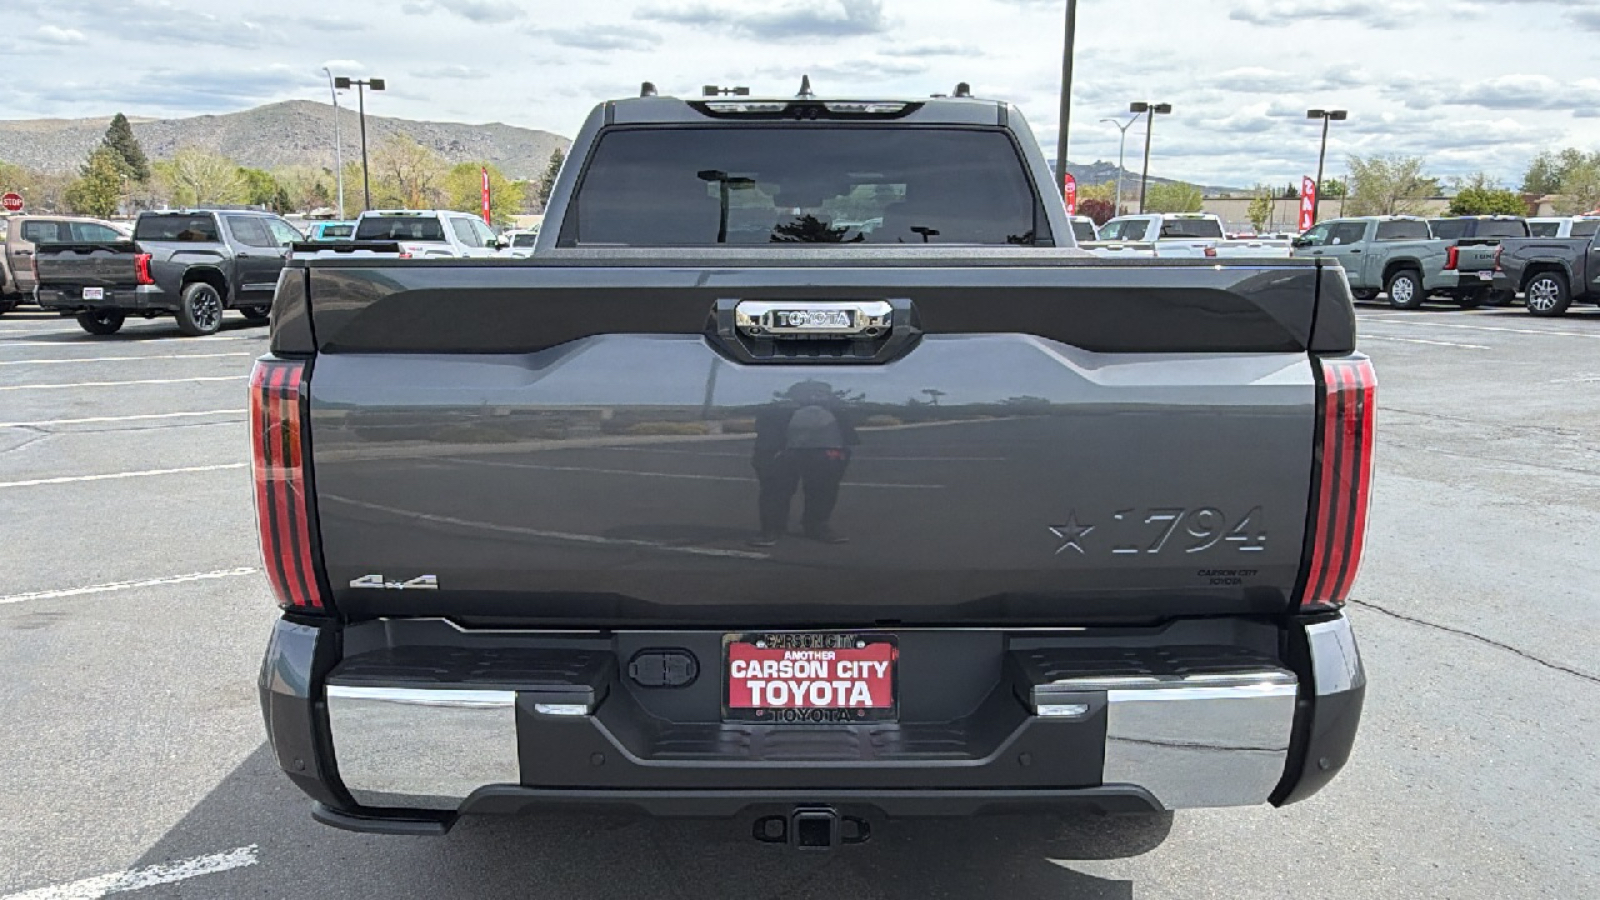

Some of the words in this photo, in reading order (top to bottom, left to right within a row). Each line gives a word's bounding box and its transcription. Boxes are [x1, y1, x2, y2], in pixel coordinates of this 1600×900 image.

[3, 198, 21, 206] STOP
[1301, 179, 1313, 230] SAL
[777, 310, 851, 326] TOYOTA
[1111, 505, 1267, 554] 1794
[765, 634, 822, 649] CARSON
[826, 634, 857, 649] CITY
[784, 650, 836, 660] ANOTHER
[731, 660, 828, 678] CARSON
[837, 660, 889, 678] CITY
[747, 680, 873, 706] TOYOTA
[772, 708, 850, 722] TOYOTA
